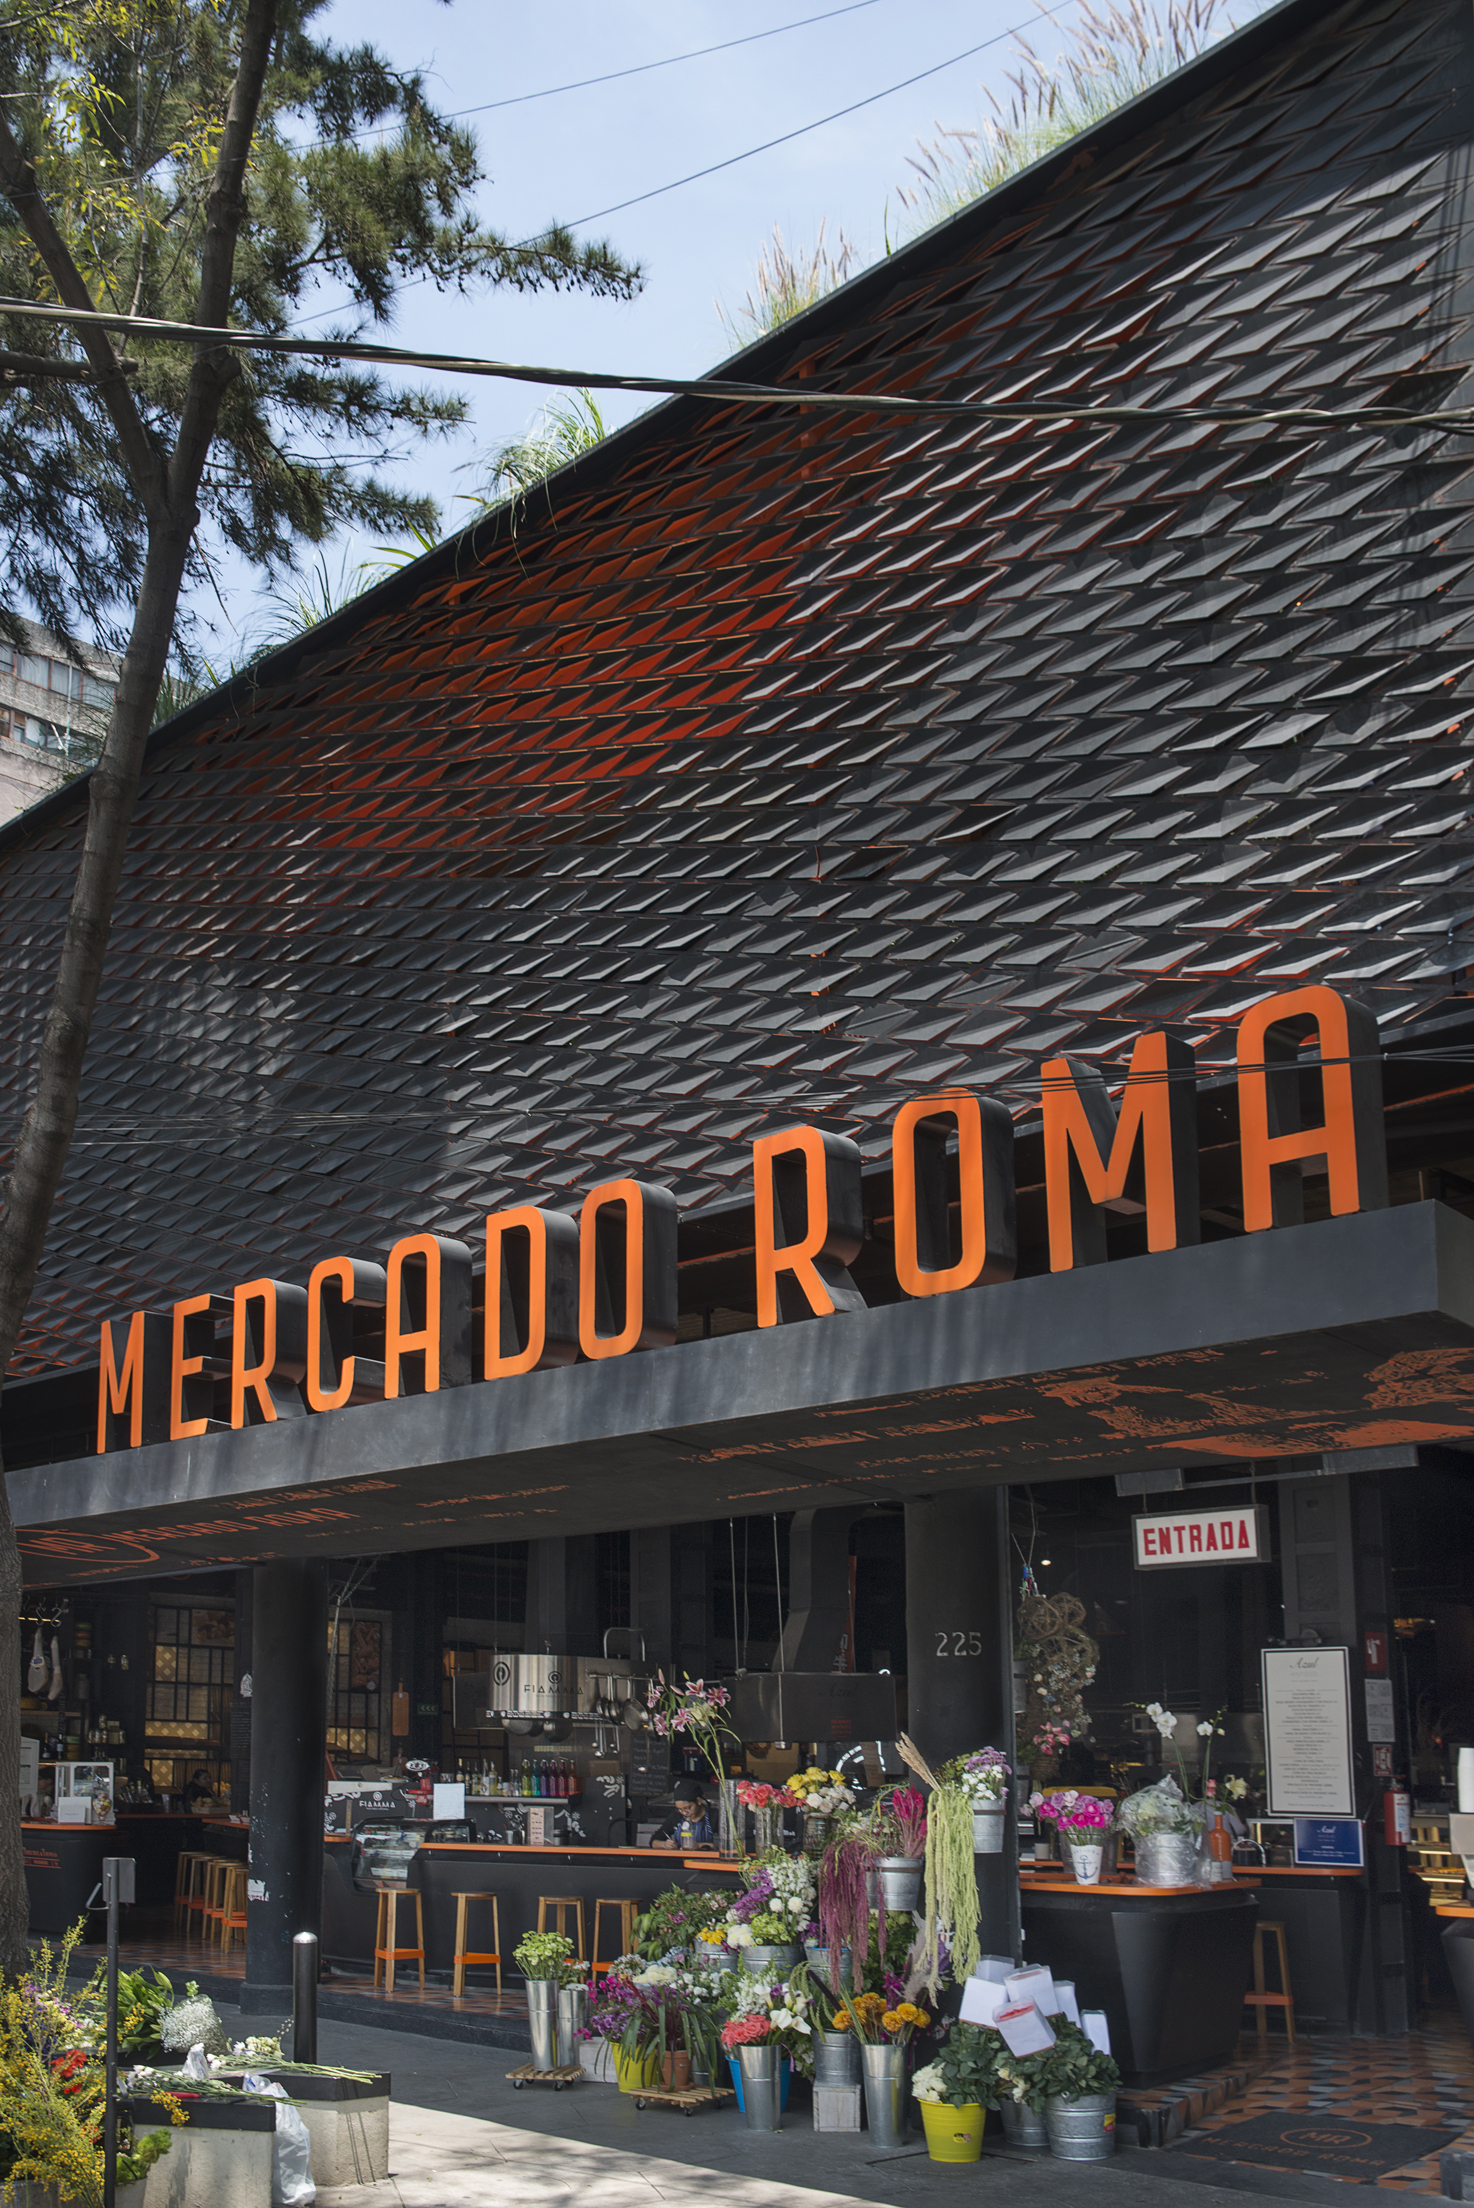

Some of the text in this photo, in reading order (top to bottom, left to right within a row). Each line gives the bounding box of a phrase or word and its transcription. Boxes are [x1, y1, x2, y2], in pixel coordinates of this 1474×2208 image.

[97, 984, 1360, 1454] MERCADO ROMA
[101, 1518, 259, 1543] MERCADO
[242, 1506, 361, 1527] ROMA
[1142, 1519, 1250, 1555] ENTRADA
[934, 1631, 982, 1657] 225
[523, 1683, 584, 1695] FIAMMA
[358, 1799, 396, 1808] FIAMMA
[1297, 2130, 1352, 2144] MR
[1202, 2136, 1386, 2167] MERCADO ROMA
